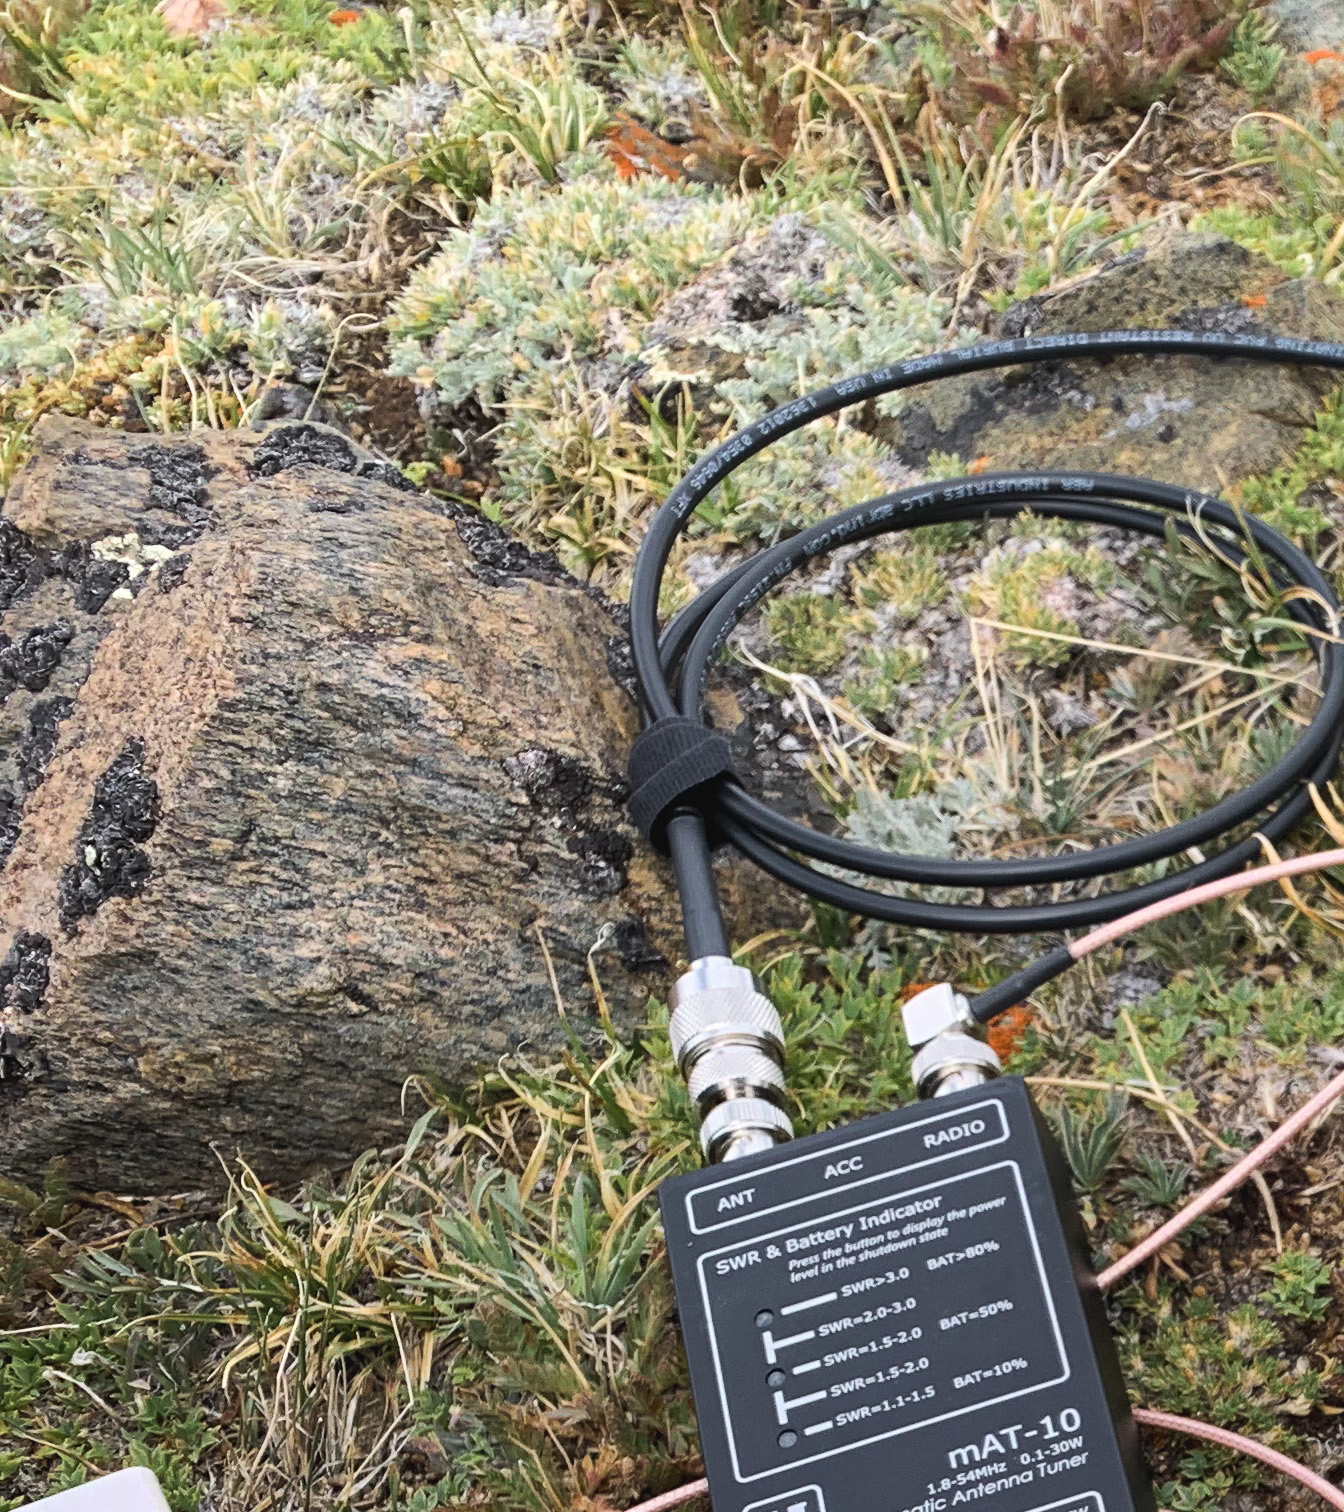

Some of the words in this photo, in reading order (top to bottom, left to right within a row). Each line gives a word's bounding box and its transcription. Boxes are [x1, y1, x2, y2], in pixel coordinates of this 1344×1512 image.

[717, 1188, 756, 1213] ANT
[824, 1156, 864, 1180] ACC
[923, 1120, 986, 1149] RADIO
[716, 1250, 762, 1275] SWR
[766, 1244, 782, 1259] &
[786, 1223, 854, 1253] Battery
[859, 1196, 943, 1231] Indicator
[788, 1255, 820, 1271] Press
[823, 1248, 842, 1259] the
[845, 1234, 884, 1253] button
[887, 1229, 900, 1240] to
[903, 1216, 945, 1235] display
[947, 1209, 966, 1222] the
[969, 1196, 1006, 1218] power
[790, 1266, 818, 1284] level
[821, 1263, 833, 1274] in
[836, 1256, 856, 1269] the
[859, 1237, 916, 1263] shutdown
[919, 1227, 948, 1243] state
[841, 1267, 909, 1298] SWR>3.0
[926, 1240, 1000, 1271] BAT>80%
[818, 1298, 917, 1337] SWR=2.0-3.0
[823, 1327, 923, 1367] SWR=1.5-2.0
[939, 1299, 1014, 1331] BAT=50%
[830, 1357, 929, 1398] SWR=1.5-2.0
[835, 1385, 935, 1427] SWR=1.1-1.5
[953, 1357, 1028, 1389] BAT=10%
[927, 1461, 1007, 1495] 1.8-54MHz
[1020, 1436, 1083, 1466] 0.1-30W
[948, 1407, 1082, 1469] mAT-10
[952, 1470, 1034, 1506] Antenna
[1037, 1452, 1089, 1478] Tuner
